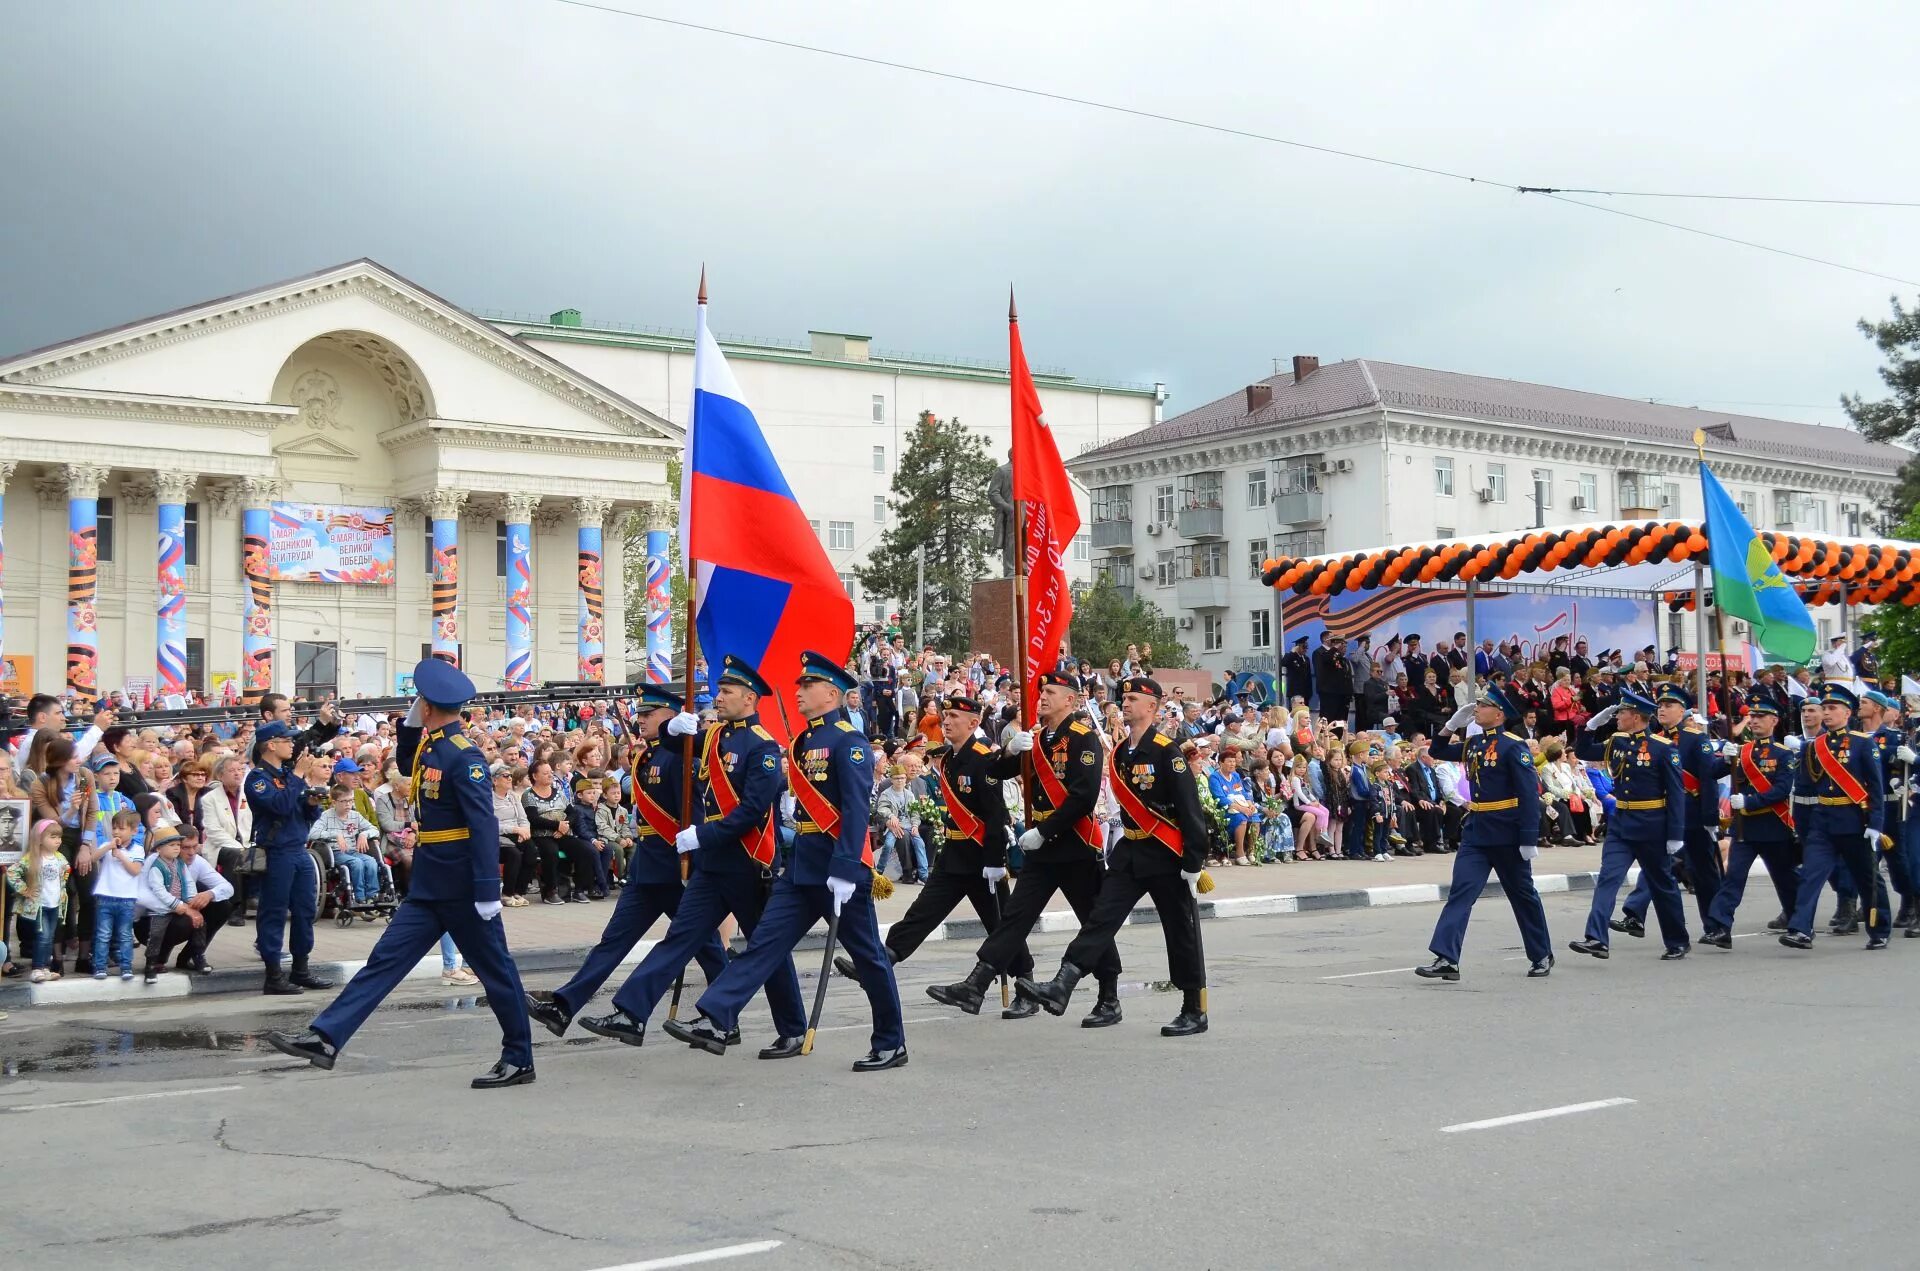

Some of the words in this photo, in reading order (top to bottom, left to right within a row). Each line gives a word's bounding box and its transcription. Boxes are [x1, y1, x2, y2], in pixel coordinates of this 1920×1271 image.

[276, 528, 295, 539] МАЯ!
[330, 534, 336, 544] 9
[336, 532, 355, 543] МАЯ!
[270, 539, 313, 551] АЗДНИКОМ
[339, 541, 373, 555] ВЕЛИКОЙ
[287, 550, 314, 563] ТРУДА!
